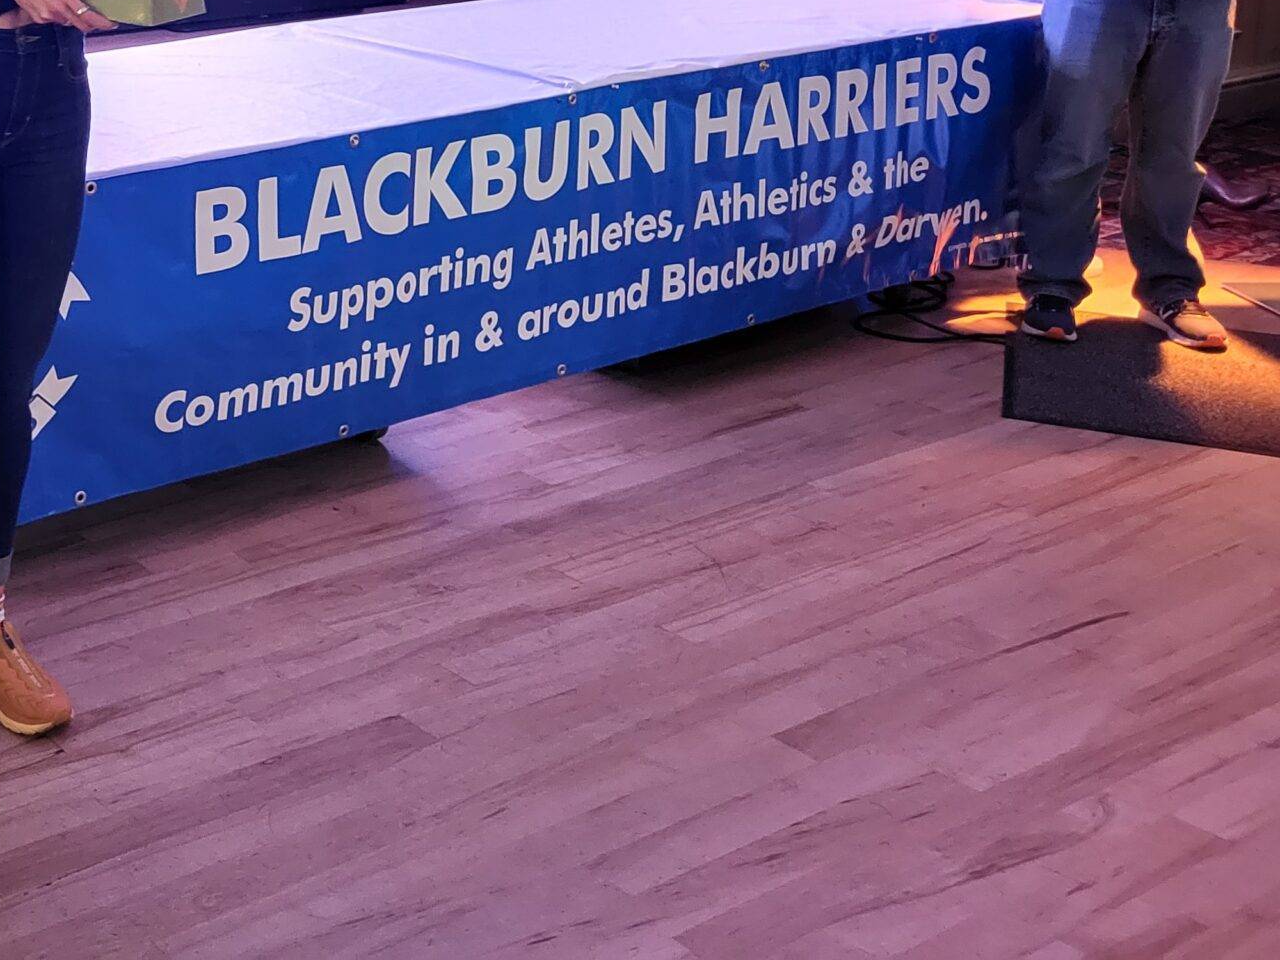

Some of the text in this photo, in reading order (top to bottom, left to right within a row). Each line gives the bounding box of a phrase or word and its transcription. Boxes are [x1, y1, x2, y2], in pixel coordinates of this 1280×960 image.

[195, 46, 992, 275] BLACKBURN HARRIERS
[287, 150, 929, 332] Supporting Athletes, Athletics & the
[154, 197, 988, 434] Community in & around Blackburn & Darwen.
